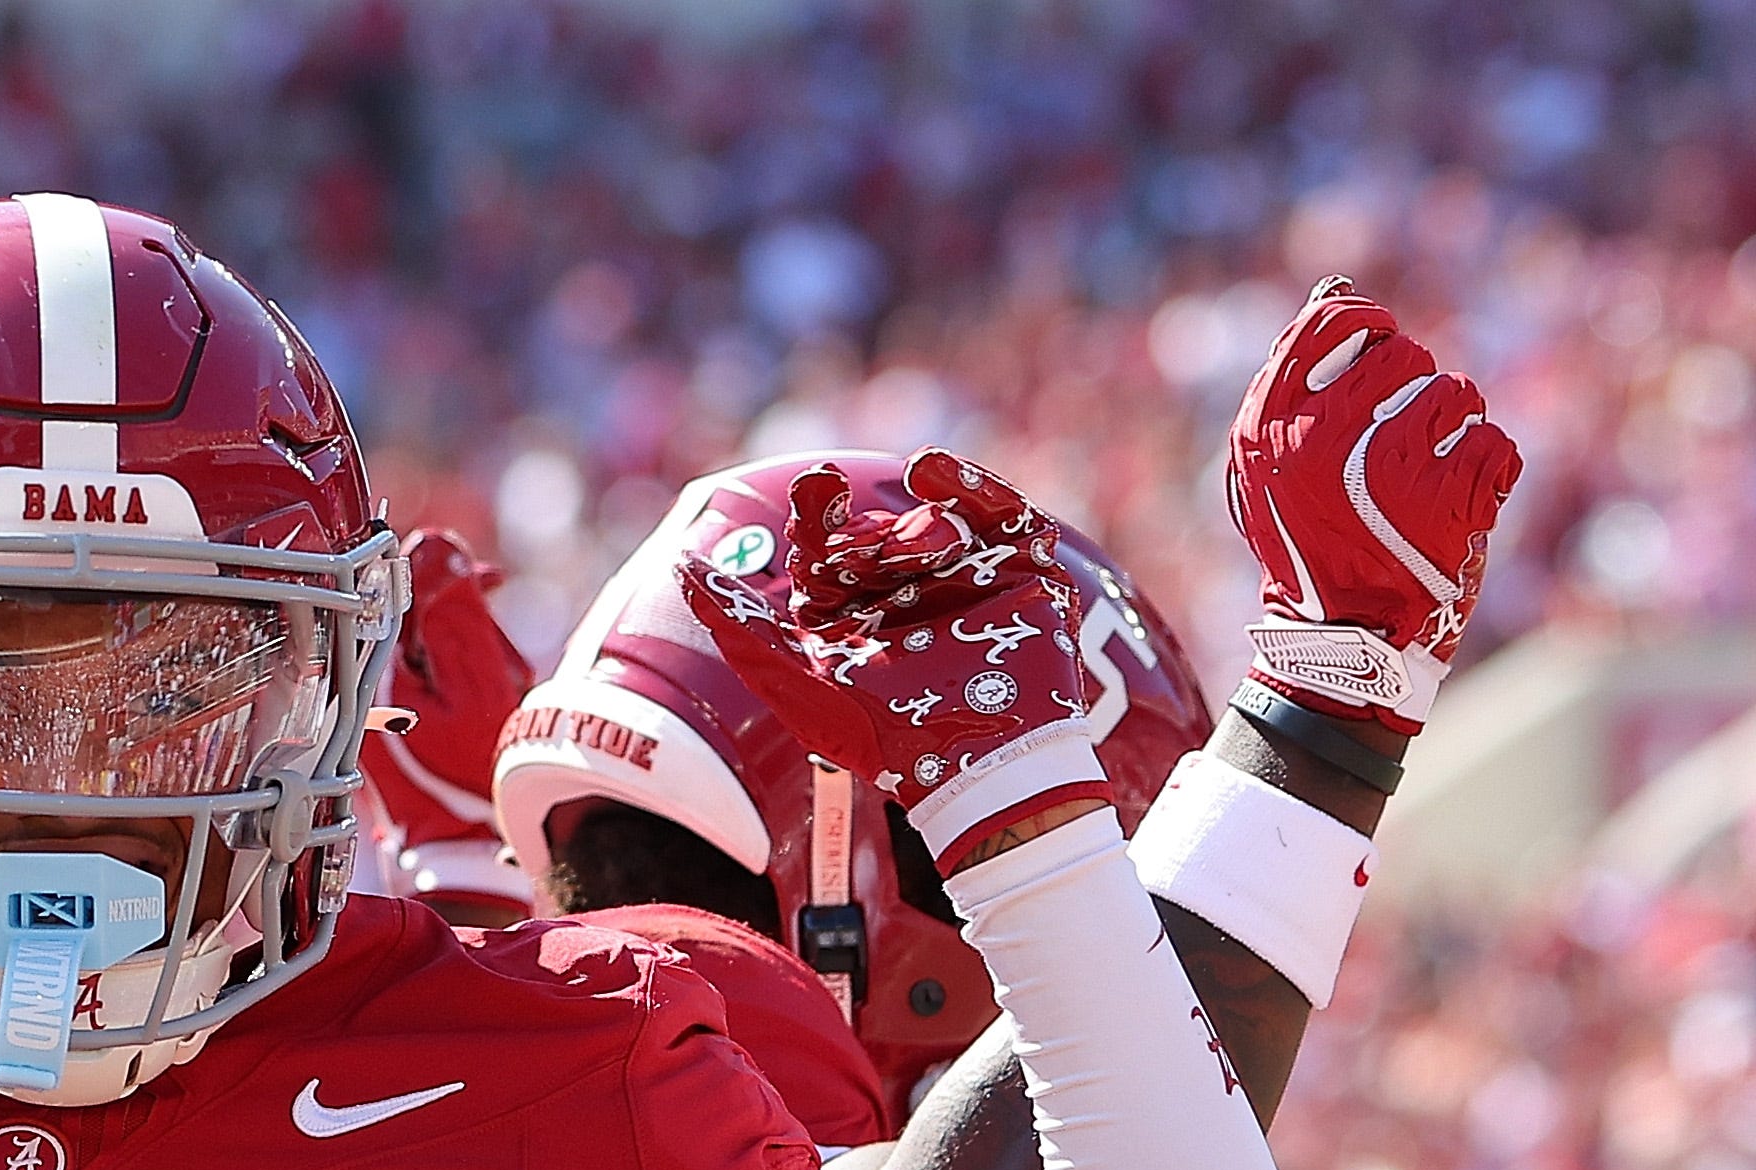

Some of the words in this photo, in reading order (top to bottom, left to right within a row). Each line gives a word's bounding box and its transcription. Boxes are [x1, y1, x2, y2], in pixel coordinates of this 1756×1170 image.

[22, 483, 149, 524] BAMA
[951, 612, 1042, 664] A
[889, 688, 943, 726] A
[569, 710, 660, 772] TIDE
[108, 896, 161, 923] NXTRND
[72, 972, 107, 1031] A
